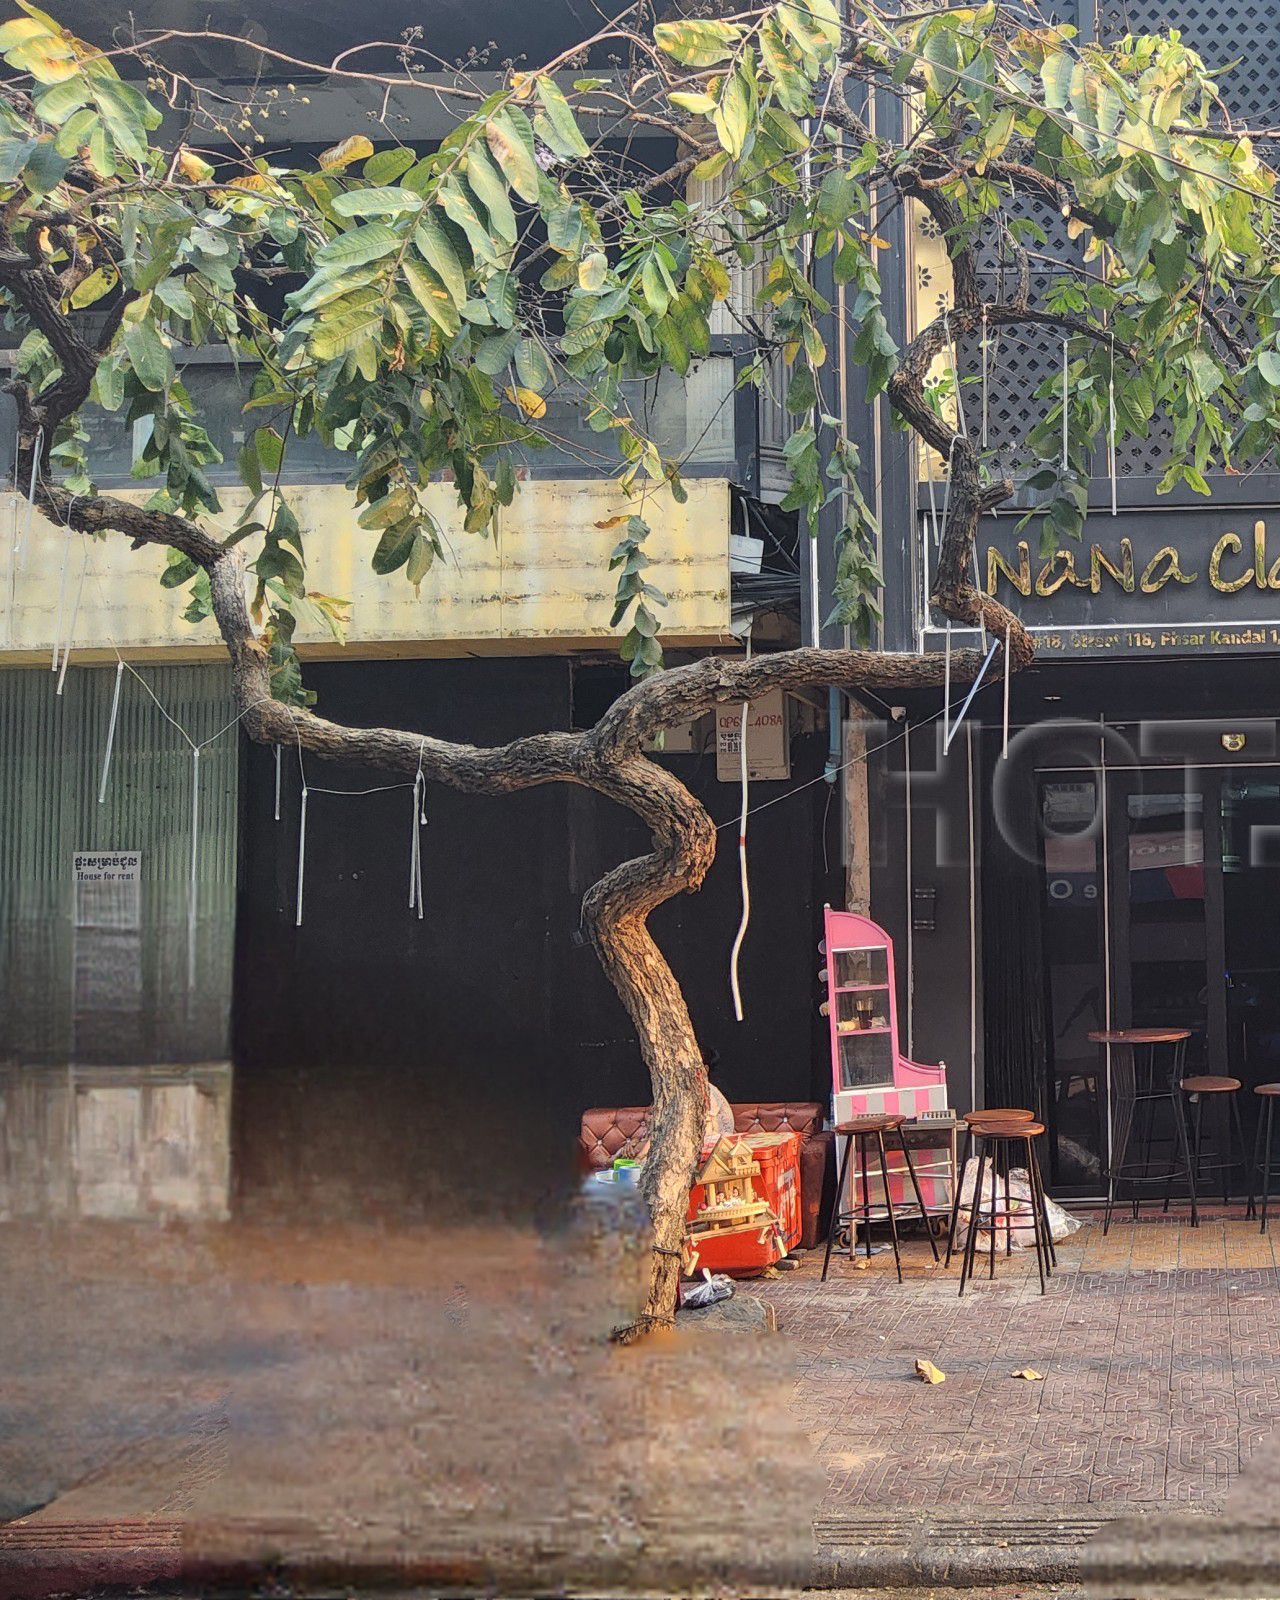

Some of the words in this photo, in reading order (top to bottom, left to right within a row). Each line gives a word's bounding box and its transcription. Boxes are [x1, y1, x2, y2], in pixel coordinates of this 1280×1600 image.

[1127, 632, 1156, 649] 118,
[77, 872, 102, 881] House
[104, 871, 115, 880] for
